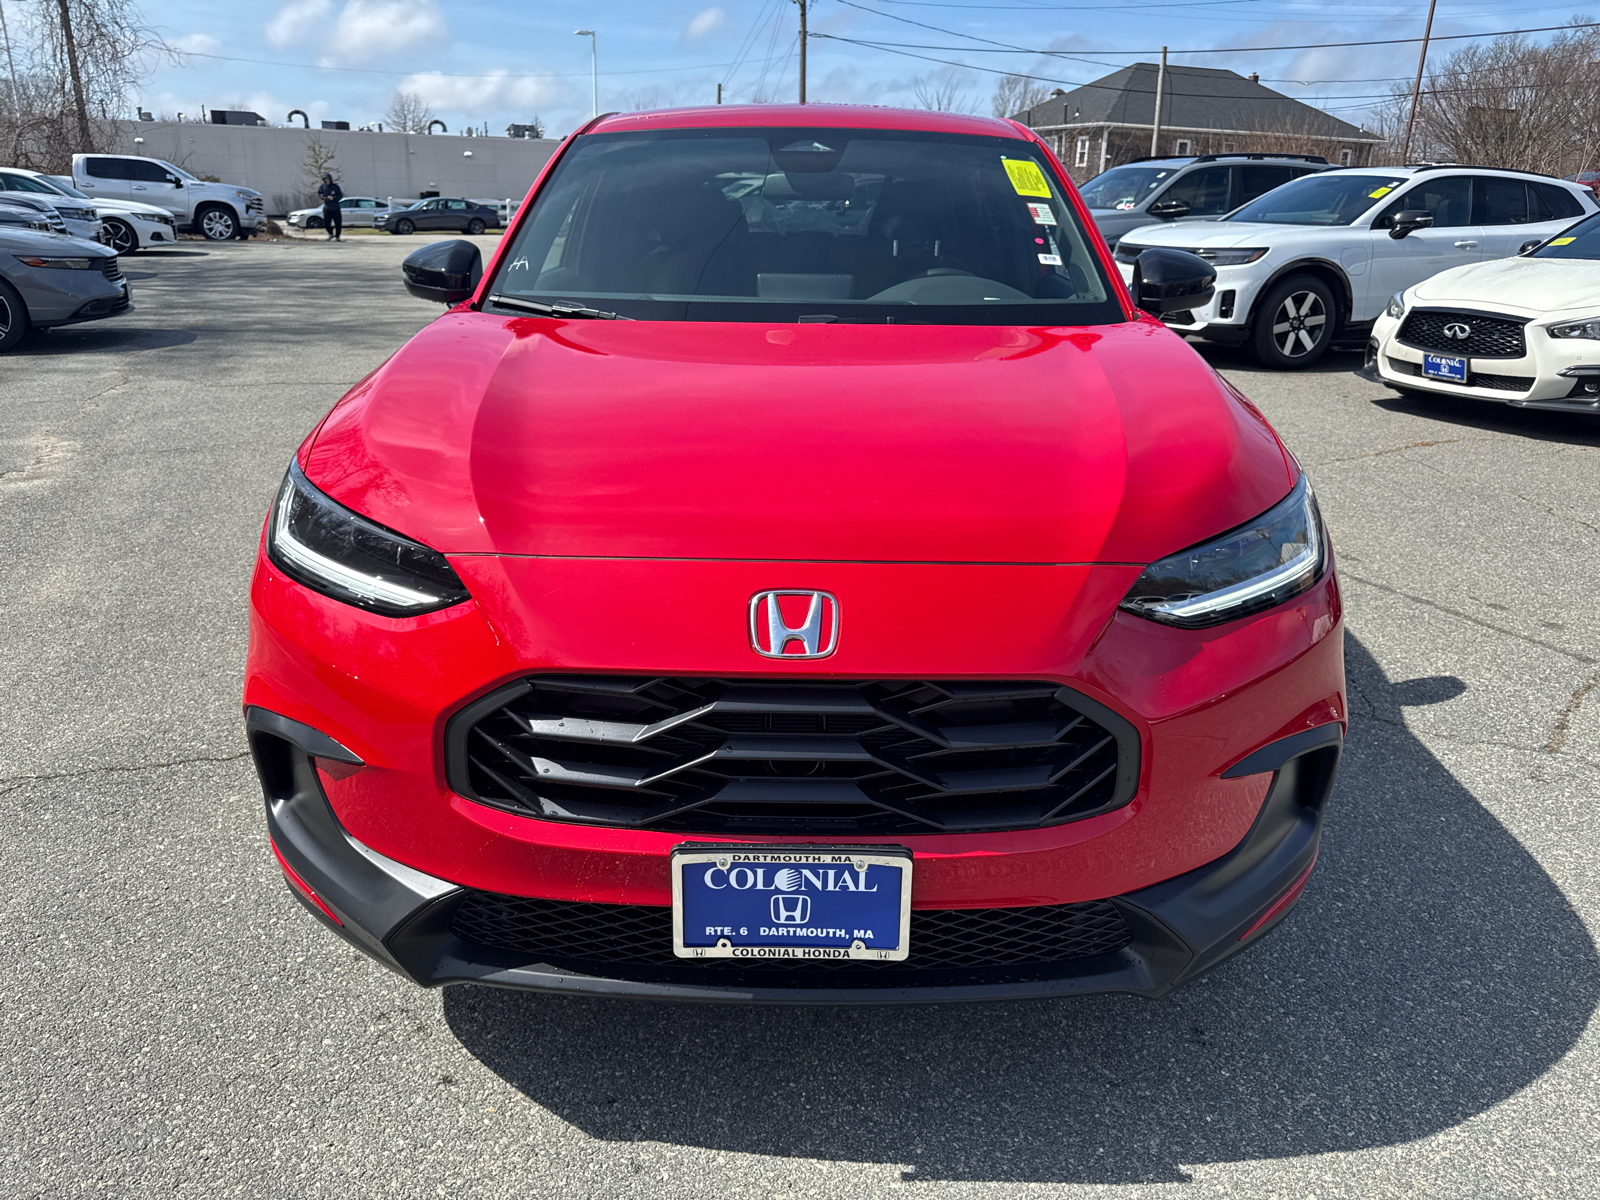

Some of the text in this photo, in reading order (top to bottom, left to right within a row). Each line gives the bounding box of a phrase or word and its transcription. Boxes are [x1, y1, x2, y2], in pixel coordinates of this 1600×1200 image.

[732, 855, 826, 863] DARTMOUTH,
[704, 867, 878, 892] COLONIAL
[705, 926, 874, 939] RTE. 6 DARTMOUTH, MA
[732, 948, 851, 958] COLONIAL HONDA
